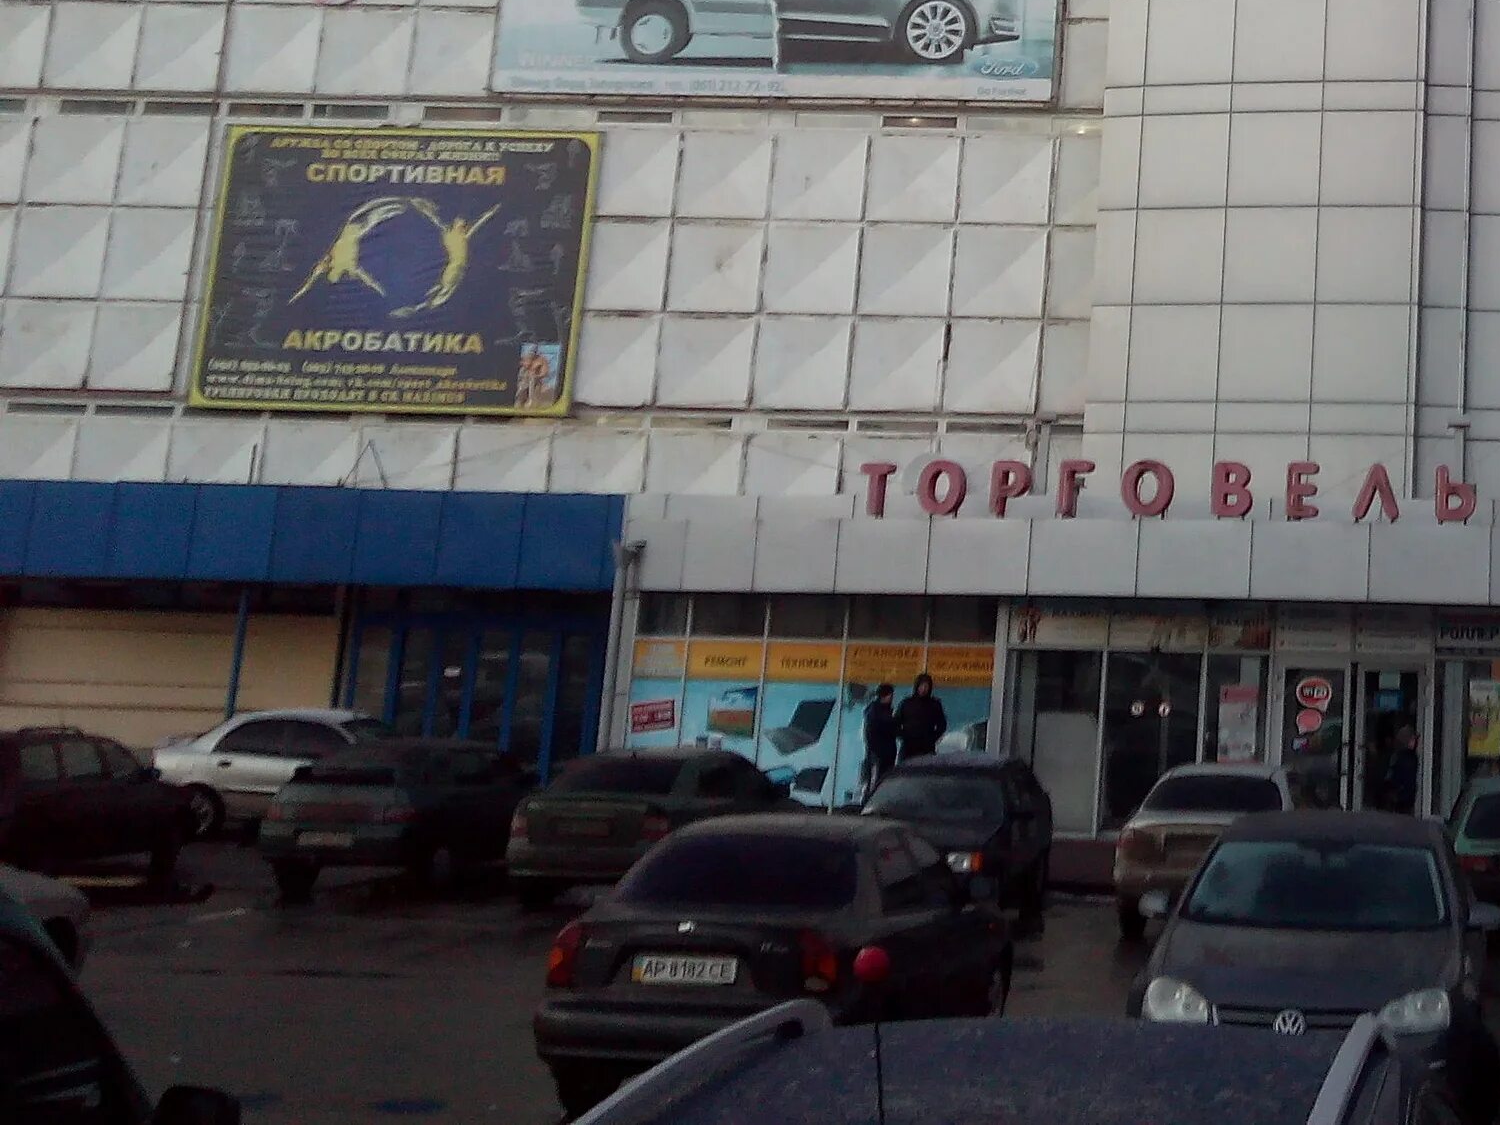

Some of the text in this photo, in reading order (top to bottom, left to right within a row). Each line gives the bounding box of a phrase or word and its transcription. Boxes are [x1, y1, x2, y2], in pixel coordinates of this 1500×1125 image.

[980, 57, 1025, 76] Ford
[306, 163, 507, 185] СПОРТИВНАЯ
[282, 330, 485, 355] АКРОБАТИКА
